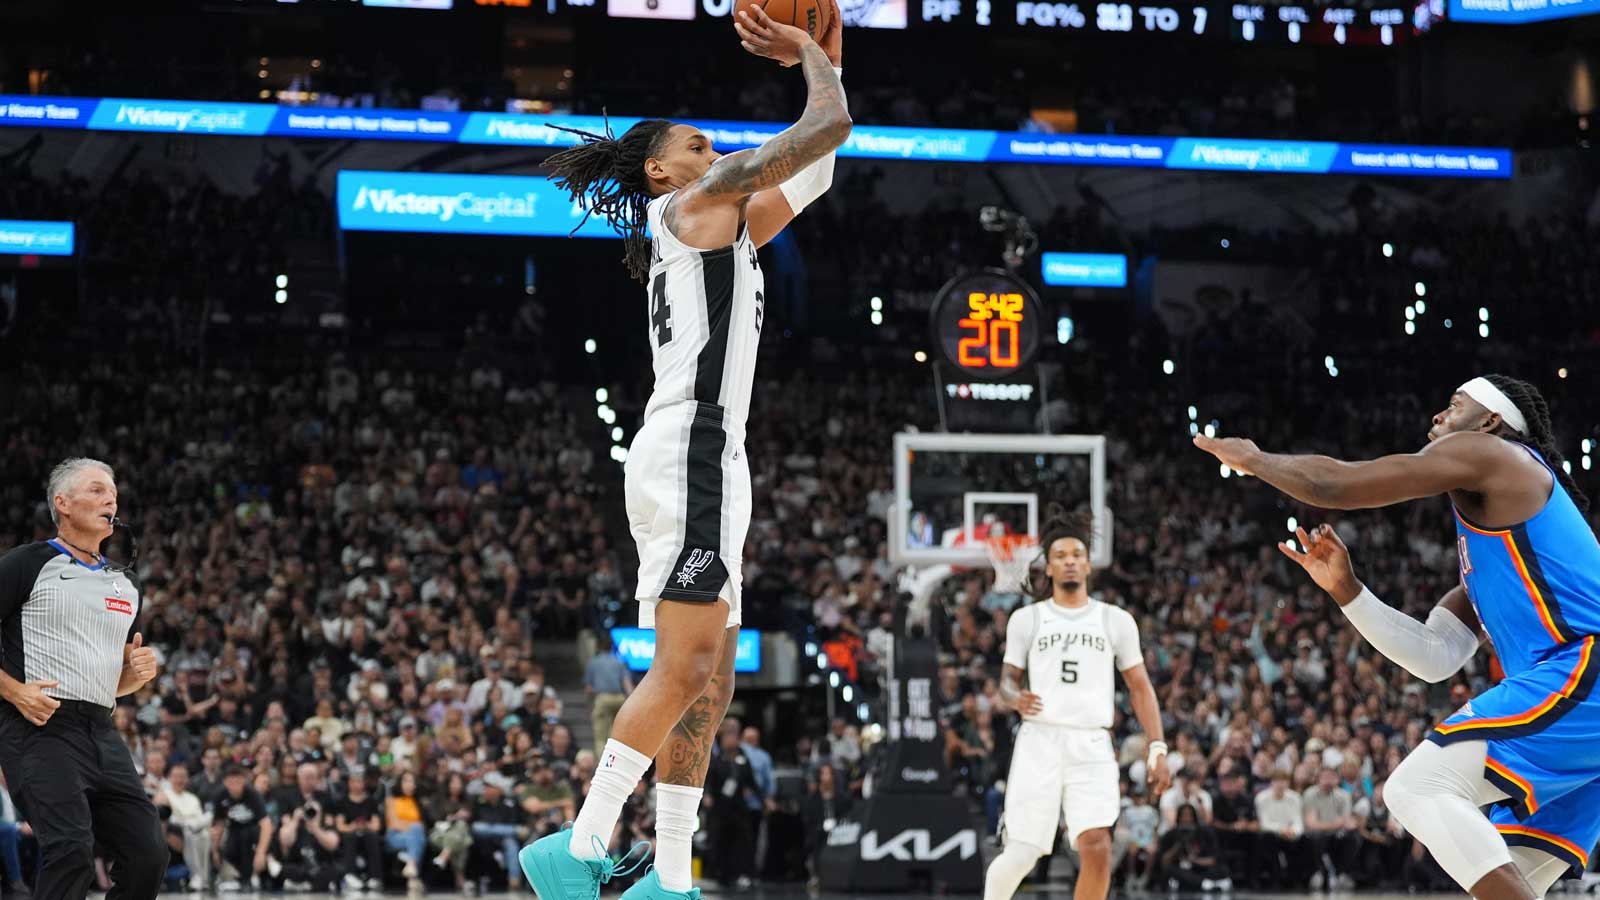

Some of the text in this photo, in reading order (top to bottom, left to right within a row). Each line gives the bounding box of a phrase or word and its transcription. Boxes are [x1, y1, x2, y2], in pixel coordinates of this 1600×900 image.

[1139, 6, 1179, 31] TO
[370, 188, 536, 222] VictoryCapital
[968, 292, 1024, 322] 5:42
[958, 318, 1020, 368] 20
[1061, 660, 1078, 684] 5
[861, 829, 977, 860] KIA
